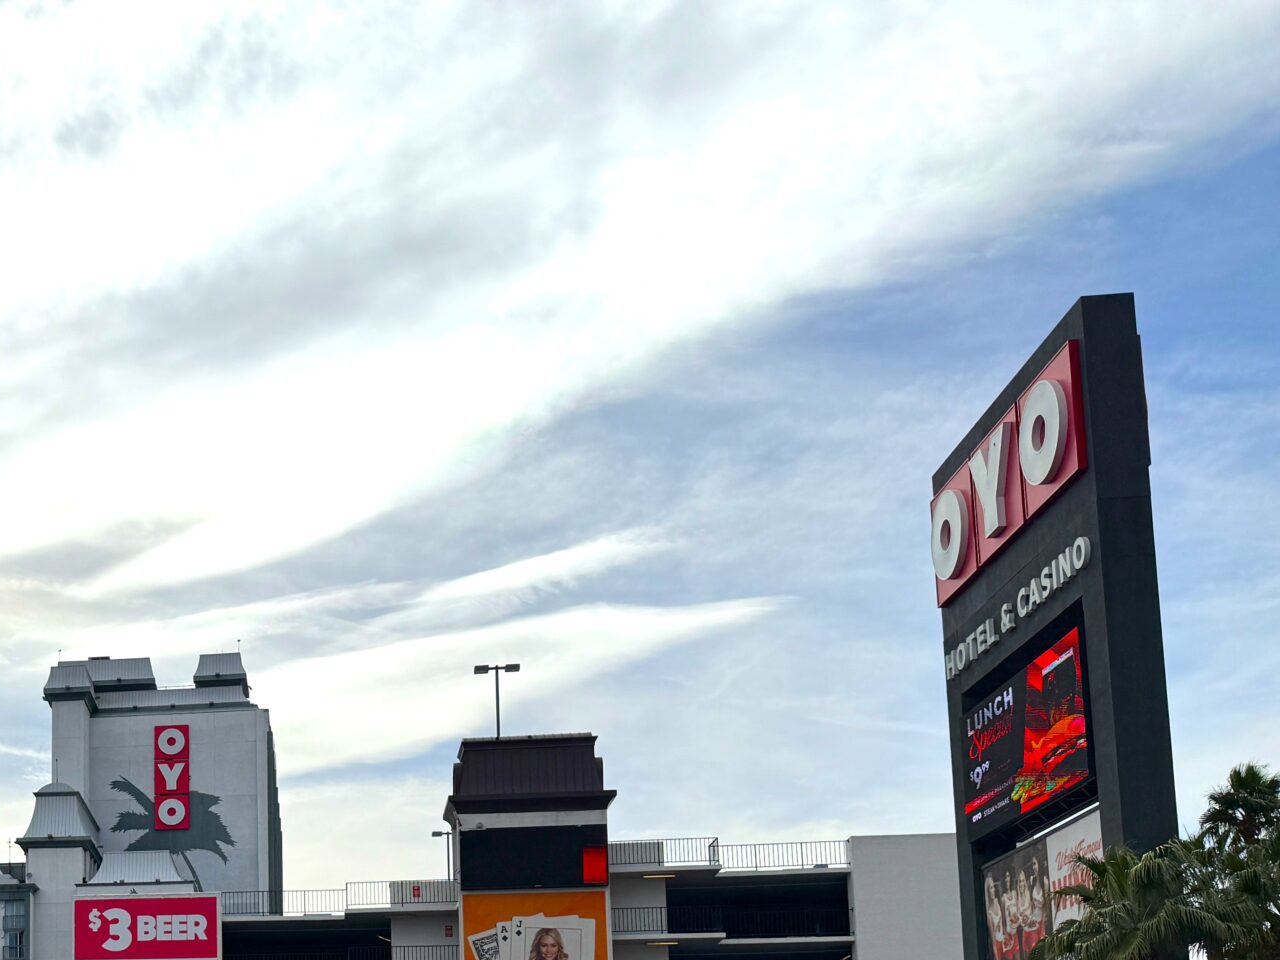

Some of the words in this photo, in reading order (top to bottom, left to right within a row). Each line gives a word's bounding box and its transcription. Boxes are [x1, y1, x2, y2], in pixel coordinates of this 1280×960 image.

[931, 379, 1068, 580] OYO
[946, 618, 999, 680] HOTEL
[1001, 602, 1016, 633] &
[1017, 536, 1091, 621] CASINO
[967, 687, 1013, 737] LUNCH
[158, 728, 185, 825] OYO
[88, 907, 133, 952] $3
[136, 914, 208, 941] BEER
